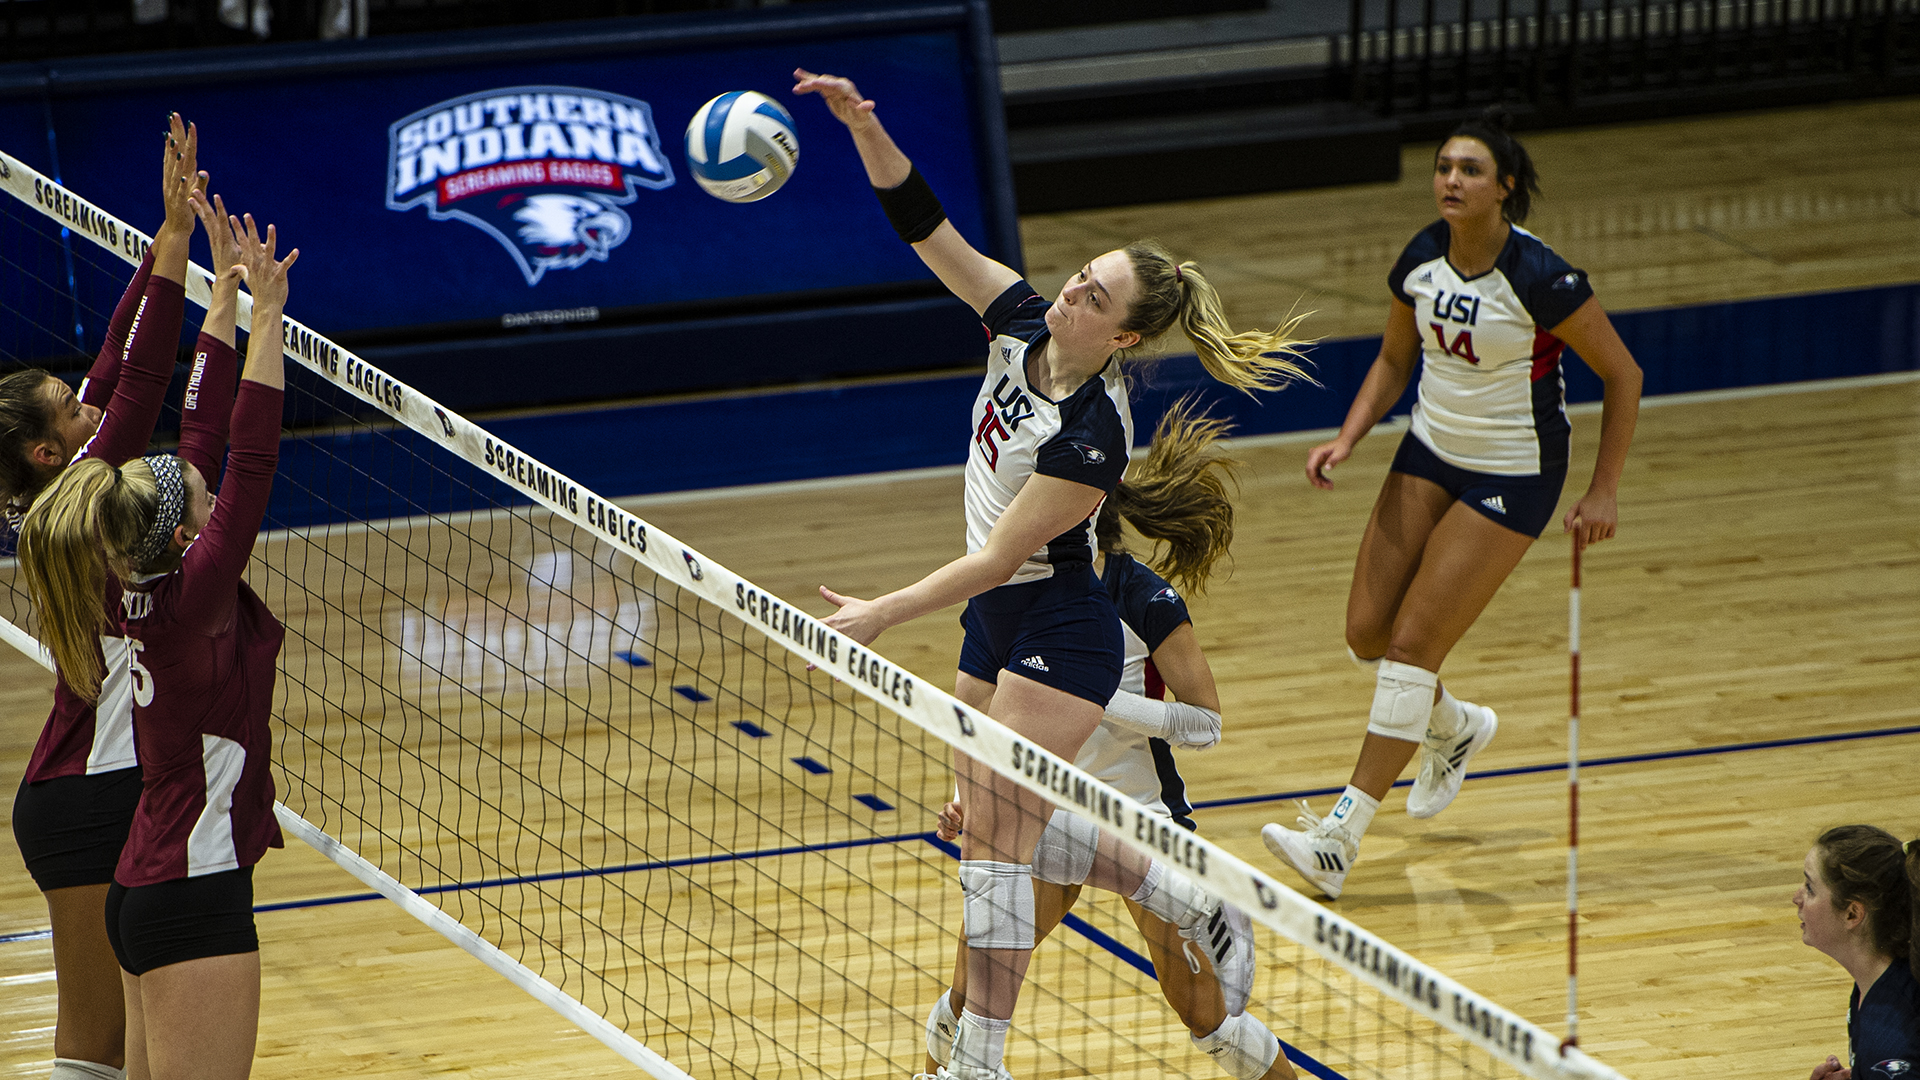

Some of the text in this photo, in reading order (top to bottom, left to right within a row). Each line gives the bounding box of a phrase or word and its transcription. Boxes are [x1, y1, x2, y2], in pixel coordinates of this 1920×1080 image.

[396, 122, 663, 196] INDIANA
[399, 94, 648, 154] SOUTHERN
[445, 160, 614, 200] SCREAMING EAGLES
[34, 178, 150, 262] SCREAMING EAG
[121, 294, 148, 361] INDIANAPOLIS
[1430, 321, 1480, 366] 14
[1433, 289, 1480, 326] USI
[184, 351, 208, 410] GREYHOUNDS
[282, 319, 403, 413] EAMING EAGLES
[992, 373, 1035, 433] USI
[976, 399, 1011, 474] 15
[485, 438, 647, 554] SCREAMING EAGLES
[736, 582, 914, 707] SCREAMING EAGLES
[1011, 740, 1208, 876] SCREAMING EAGLES
[1314, 913, 1441, 1010] SCREAMING
